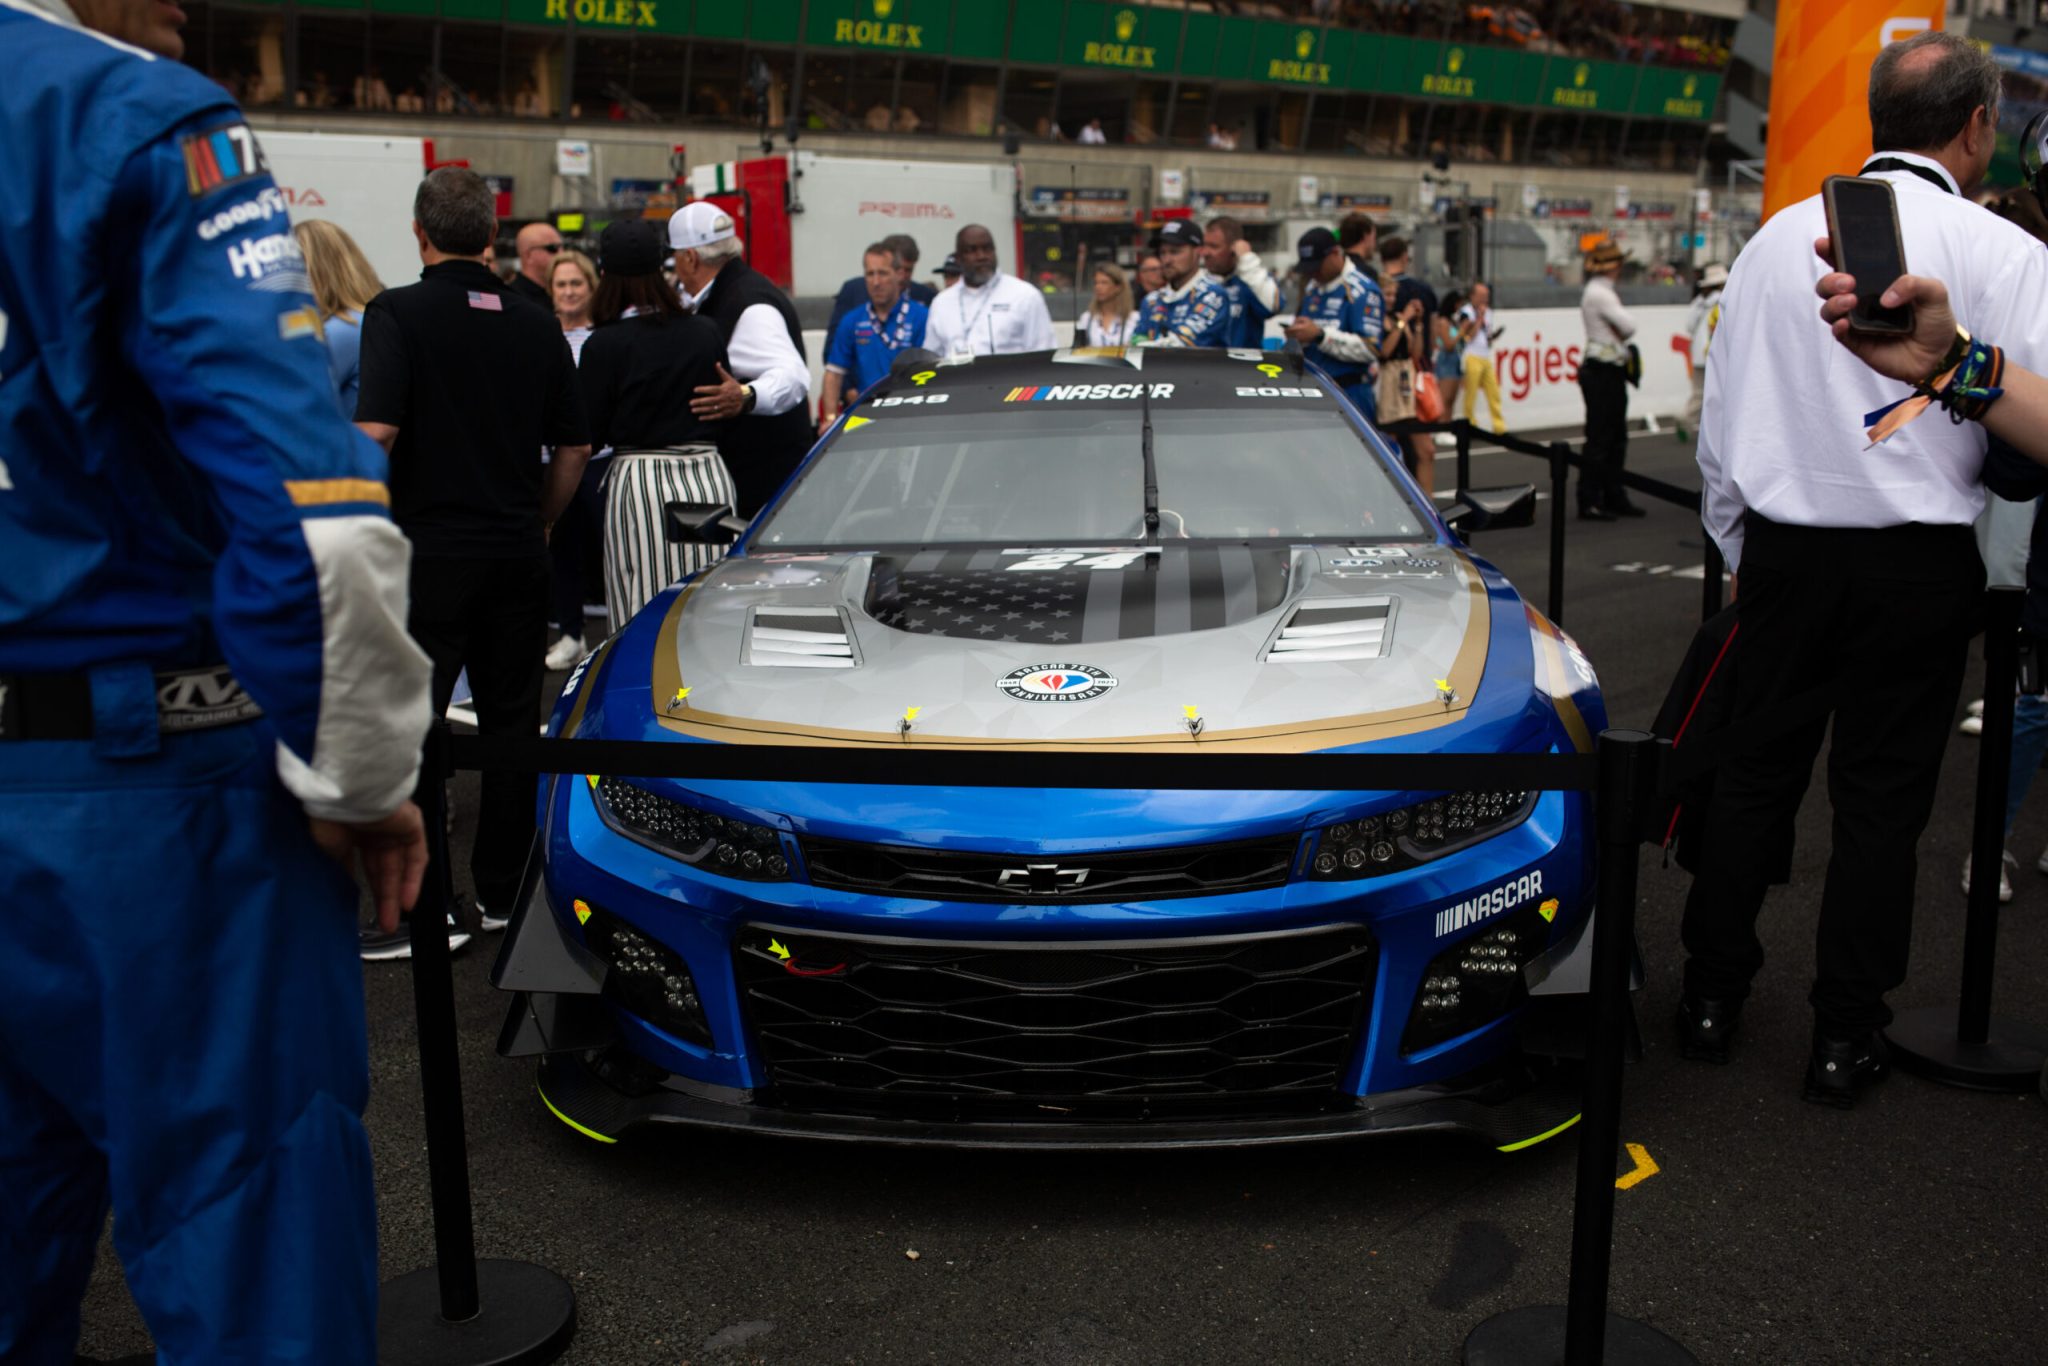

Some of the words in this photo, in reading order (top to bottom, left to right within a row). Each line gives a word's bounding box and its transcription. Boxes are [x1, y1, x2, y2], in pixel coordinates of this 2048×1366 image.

[545, 0, 657, 26] ROLEX
[835, 19, 922, 48] ROLEX
[1084, 42, 1155, 68] ROLEX
[1268, 59, 1331, 84] ROLEX
[1422, 74, 1476, 97] ROLEX
[872, 394, 950, 408] 1948
[1235, 386, 1324, 398] 2023
[1004, 552, 1146, 571] 24
[1014, 663, 1067, 677] NASCAR
[1070, 663, 1103, 677] 75TH
[1008, 686, 1103, 701] ANNIVERSARY
[1462, 869, 1544, 928] NASCAR
